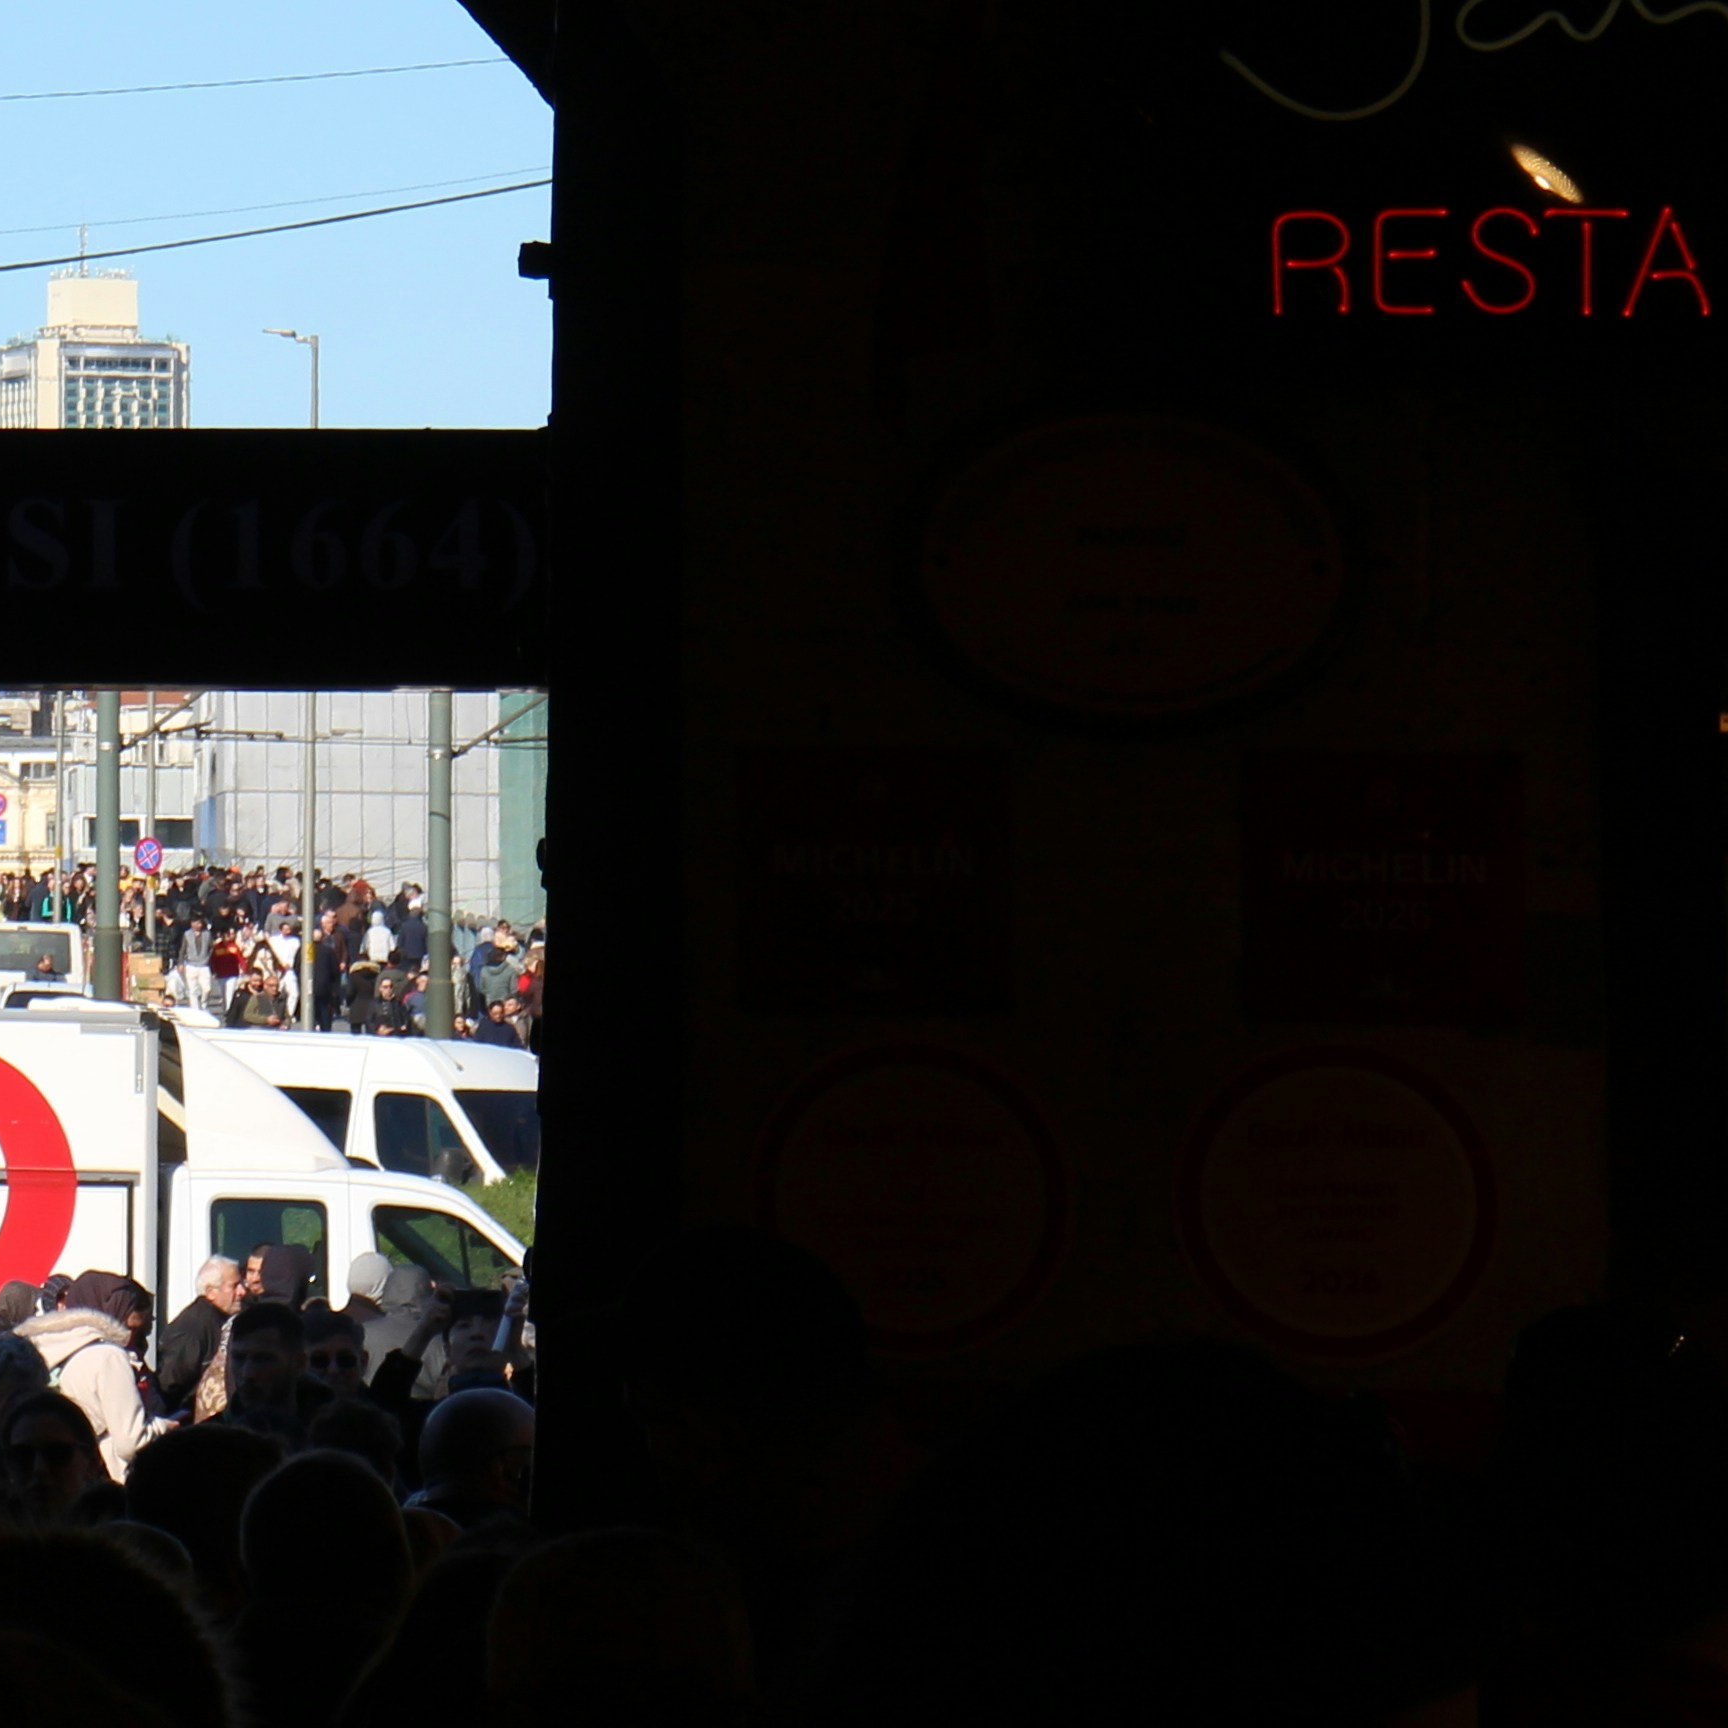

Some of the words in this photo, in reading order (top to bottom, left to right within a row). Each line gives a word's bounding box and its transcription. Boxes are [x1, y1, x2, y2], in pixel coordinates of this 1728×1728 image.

[1268, 202, 1713, 319] RESTA
[170, 495, 537, 611] (1664)
[773, 843, 974, 876] MICHELIN
[1281, 851, 1489, 885] MICHELIN
[1340, 899, 1433, 931] 2026
[1301, 1268, 1383, 1294] 2026
